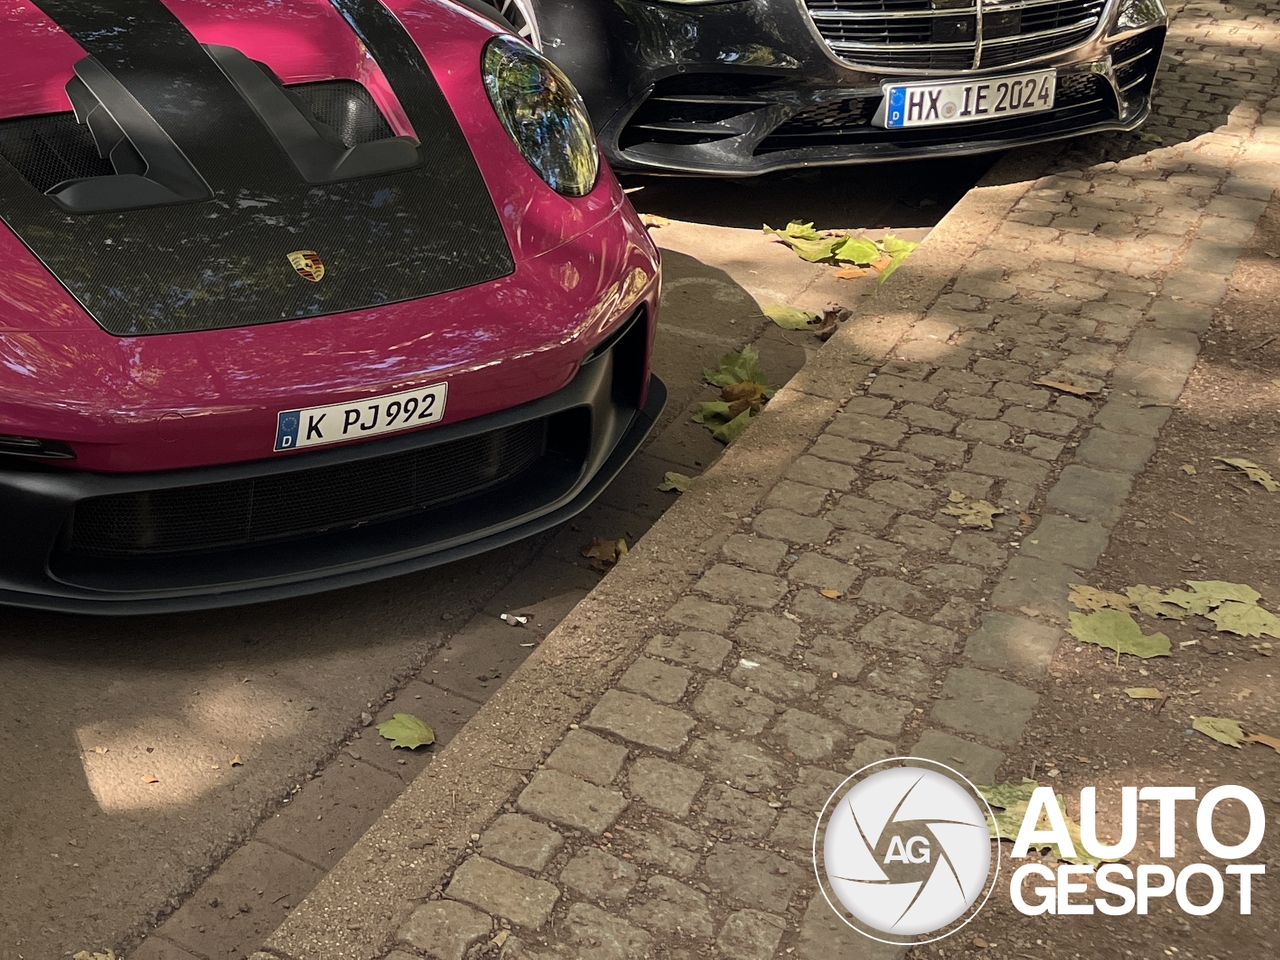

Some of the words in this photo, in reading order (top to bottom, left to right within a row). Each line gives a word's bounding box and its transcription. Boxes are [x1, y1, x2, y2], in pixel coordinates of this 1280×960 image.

[892, 111, 900, 121] D
[907, 89, 942, 121] HX
[960, 85, 990, 117] IE
[994, 76, 1050, 112] 2024
[282, 436, 292, 447] D
[306, 413, 327, 441] K
